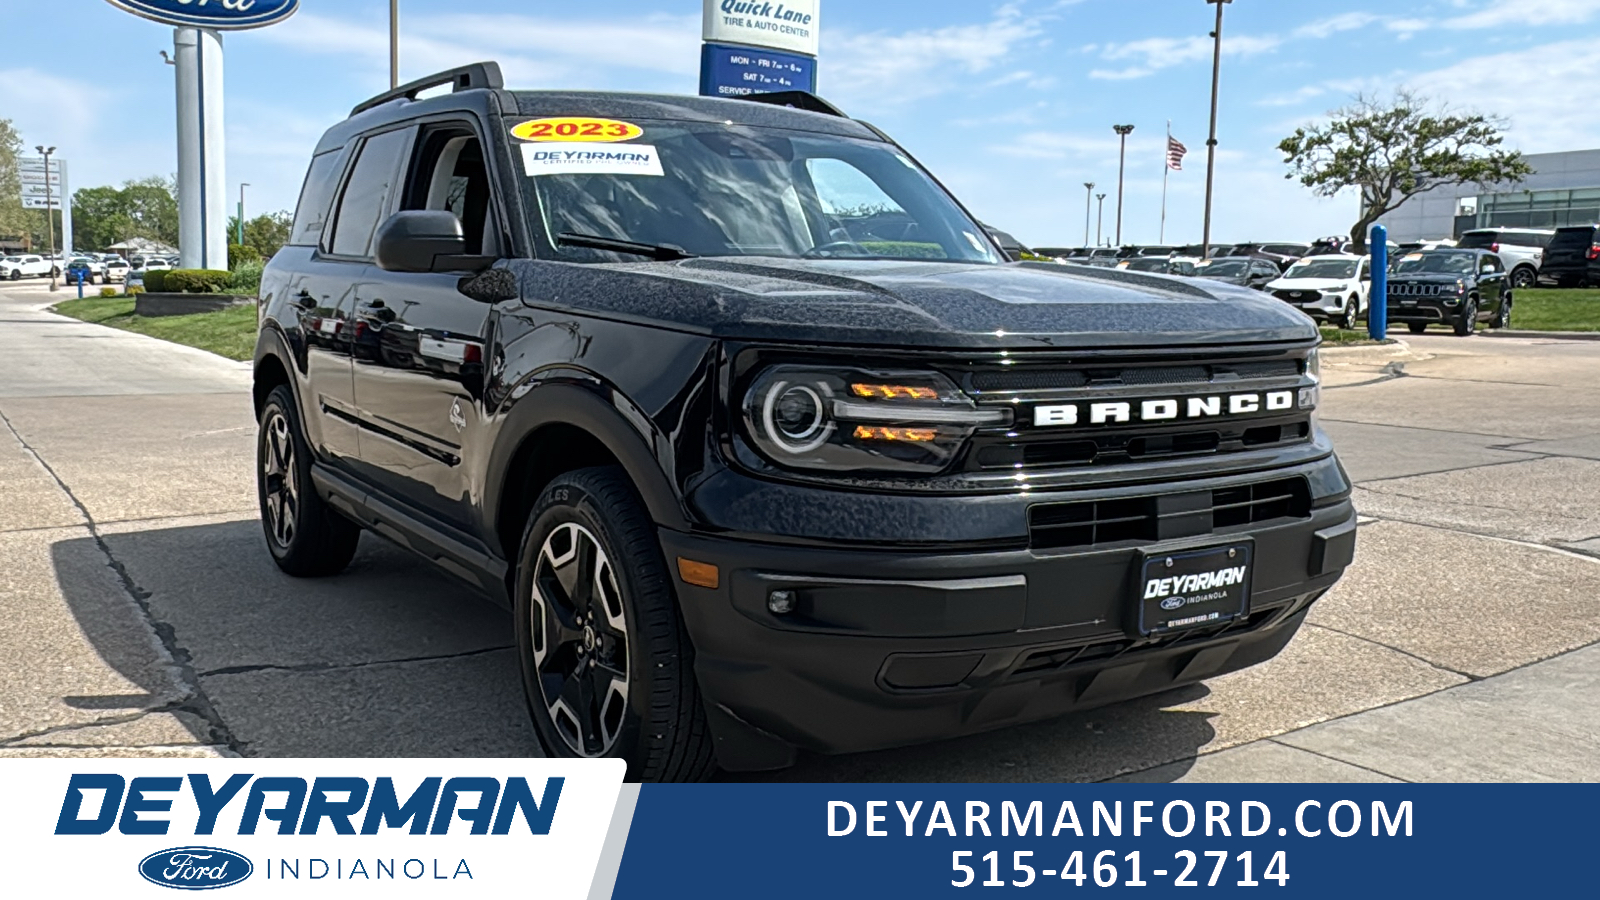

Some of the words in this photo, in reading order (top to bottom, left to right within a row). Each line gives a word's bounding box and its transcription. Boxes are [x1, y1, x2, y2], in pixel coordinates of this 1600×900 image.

[720, 0, 773, 18] Quick
[774, 4, 811, 25] Lane
[723, 16, 744, 27] TIRE
[746, 19, 753, 28] &
[754, 21, 778, 32] AUTO
[780, 24, 809, 38] CENTER
[730, 56, 749, 65] MON
[758, 59, 770, 68] FRI
[743, 72, 757, 81] SAT
[718, 86, 752, 95] SERVICE
[528, 123, 629, 137] 2023
[533, 151, 650, 162] DEYARMAN
[1034, 391, 1293, 427] BRONCO
[1143, 566, 1246, 599] DEYARMAN
[1187, 591, 1228, 604] INDIANOLA
